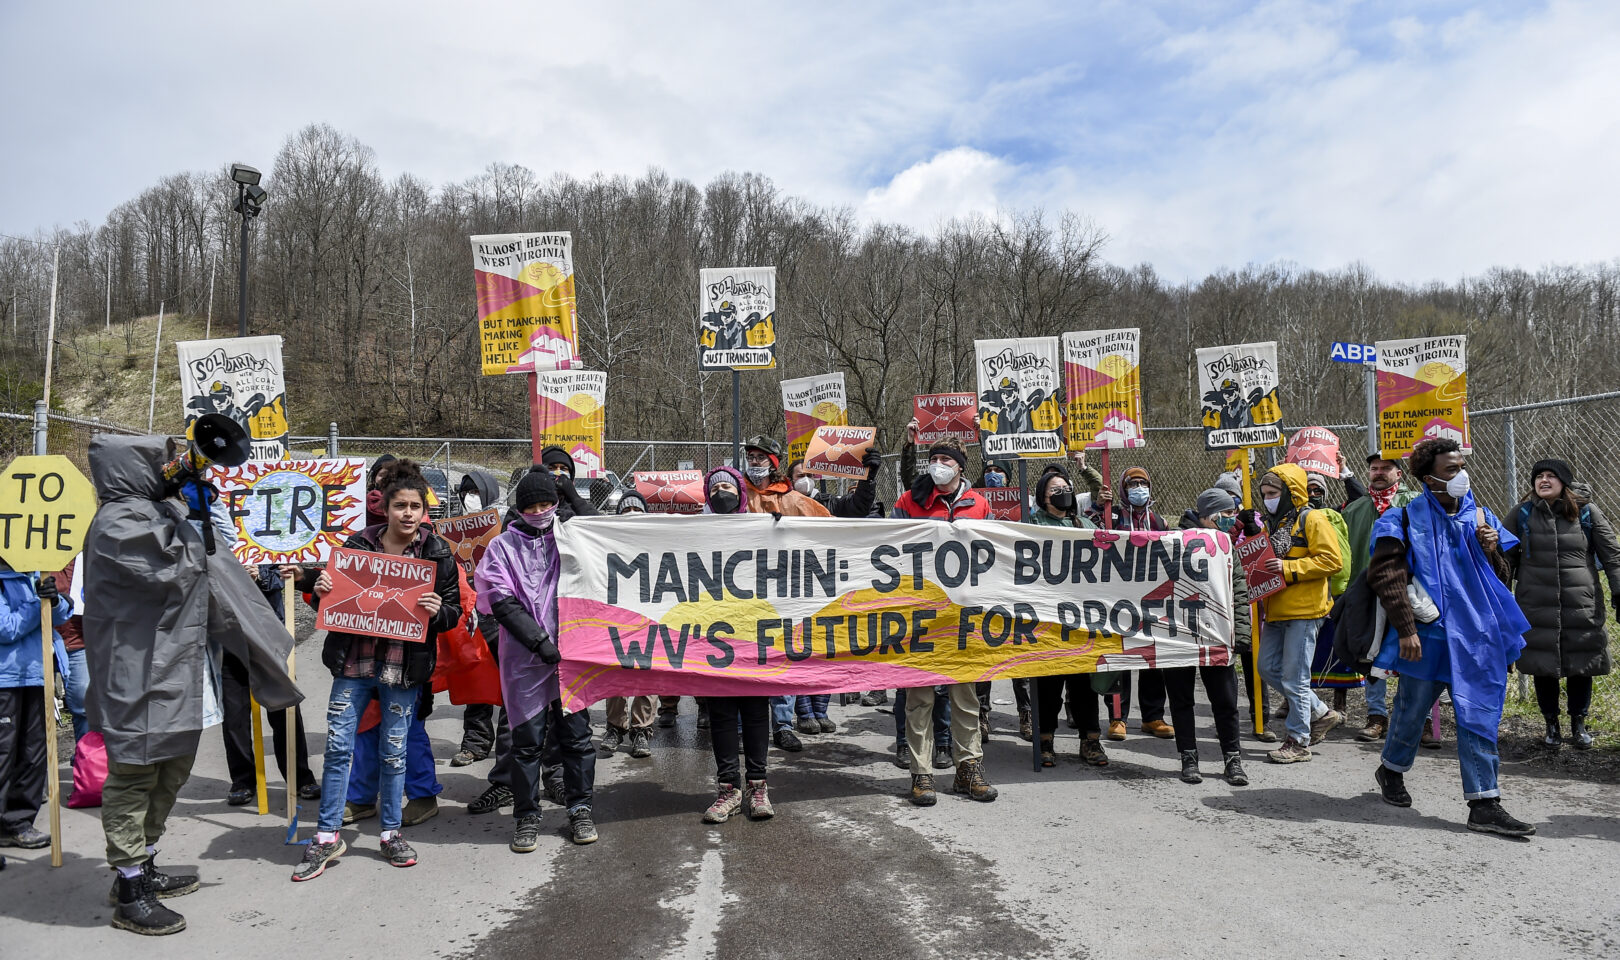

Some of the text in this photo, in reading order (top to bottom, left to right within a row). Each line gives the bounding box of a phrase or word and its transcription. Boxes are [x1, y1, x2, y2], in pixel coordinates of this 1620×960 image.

[479, 235, 568, 256] ALMOST HEAVEN
[480, 247, 566, 268] WEST VIRGINIA
[711, 279, 762, 301] SOLIDARITY
[483, 315, 561, 330] BUT MANCHIN'S
[484, 329, 523, 341] MAKING
[1068, 331, 1137, 349] ALMOST HEAVEN
[485, 341, 519, 352] IT LIKE
[1069, 342, 1135, 359] WEST VIRGINIA
[1331, 342, 1376, 361] ABP
[1382, 338, 1462, 358] ALMOST HEAVEN
[485, 353, 516, 365] HELL
[705, 351, 769, 364] JUST TRANSITION
[988, 352, 1045, 378] SOLIDARITY
[1383, 349, 1459, 368] WEST VIRGINIA
[195, 352, 265, 381] SOLIDARITY
[1210, 357, 1264, 380] SOLIDARITY
[236, 377, 276, 387] ALL COAL
[542, 373, 604, 385] ALMOST HEAVEN
[1021, 375, 1033, 383] ALL
[237, 383, 275, 393] WORKERS
[543, 383, 602, 394] WEST VIRGINIA
[786, 382, 842, 400] ALMOST HEAVEN
[788, 391, 841, 408] WEST VIRGINIA
[917, 396, 975, 409] WV RISING
[1069, 403, 1083, 411] BUT
[1086, 400, 1129, 410] MANCHIN'S
[1069, 412, 1099, 420] MAKING
[1383, 408, 1453, 420] BUT MANCHIN'S
[1069, 422, 1096, 431] IT LIKE
[1383, 420, 1418, 430] MAKING
[540, 433, 593, 442] BUT MANCHIN'S
[817, 428, 873, 440] WV RISING
[918, 430, 975, 441] WORKING FAMILIES
[1070, 432, 1094, 441] HELL
[1211, 428, 1278, 445] JUST TRANSITION
[1304, 429, 1338, 446] RISING
[1383, 430, 1414, 439] IT LIKE
[791, 442, 803, 451] BUT
[988, 437, 1008, 452] JUST
[1011, 435, 1058, 450] TRANSITION
[1384, 440, 1411, 450] HELL
[249, 444, 280, 460] SITION
[806, 461, 866, 476] A JUST TRANSITION
[1298, 459, 1337, 474] FUTURE
[637, 472, 699, 482] WV RISING
[11, 472, 65, 504] TO
[229, 484, 347, 537] FIRE
[647, 503, 670, 511] ORKING
[438, 512, 497, 535] WV RISING
[0, 513, 76, 551] THE
[1238, 534, 1268, 559] ISING
[335, 551, 368, 572] WV
[371, 557, 433, 583] RISING
[606, 538, 1209, 605] MANCHIN: STOP BURNING
[1253, 576, 1281, 598] FAMILIES
[368, 590, 384, 600] FOR
[324, 610, 423, 638] WORKING FAMILIES
[608, 599, 1206, 670] WV'S FUTURE FOR PROFIT
